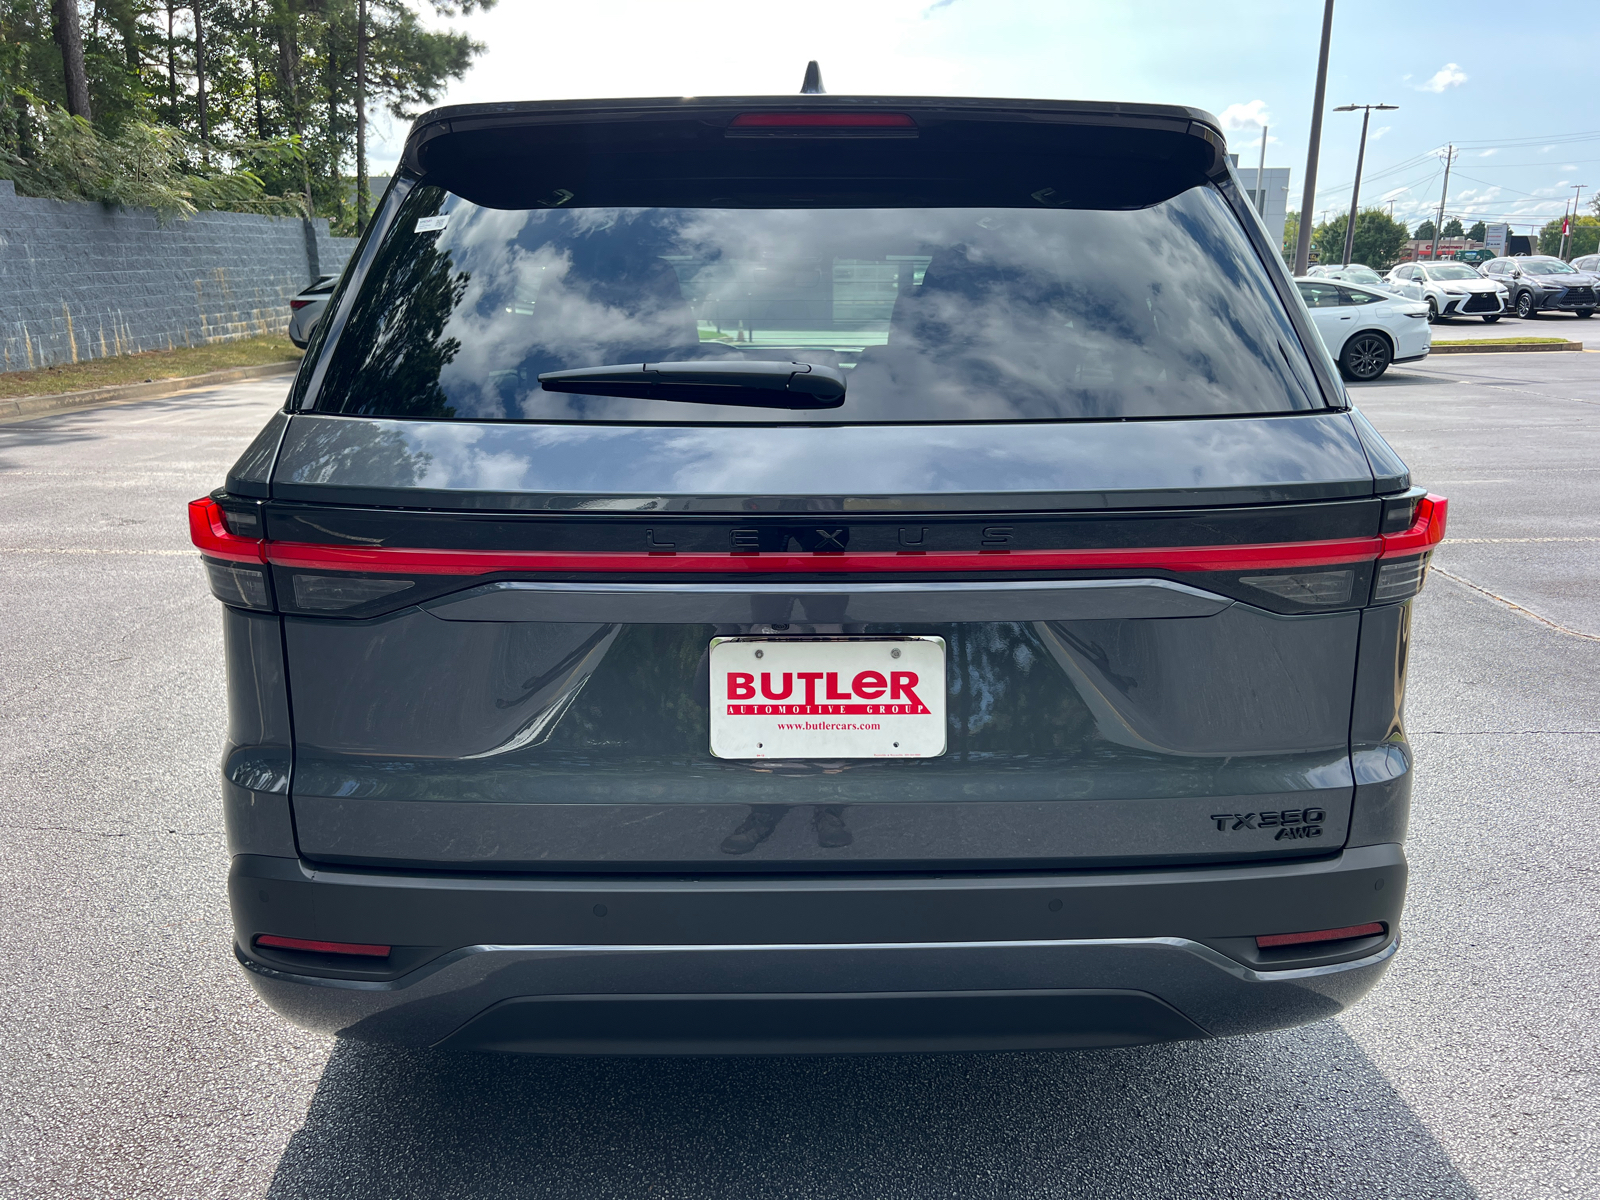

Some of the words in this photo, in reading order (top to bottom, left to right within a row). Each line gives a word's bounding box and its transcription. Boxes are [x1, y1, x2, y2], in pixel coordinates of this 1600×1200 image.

[645, 527, 1014, 547] LEXUS
[728, 705, 846, 714] AUTOMOTIVE
[866, 704, 925, 714] GROUP
[777, 721, 881, 731] www.butlercars.com
[1274, 825, 1323, 841] AWD
